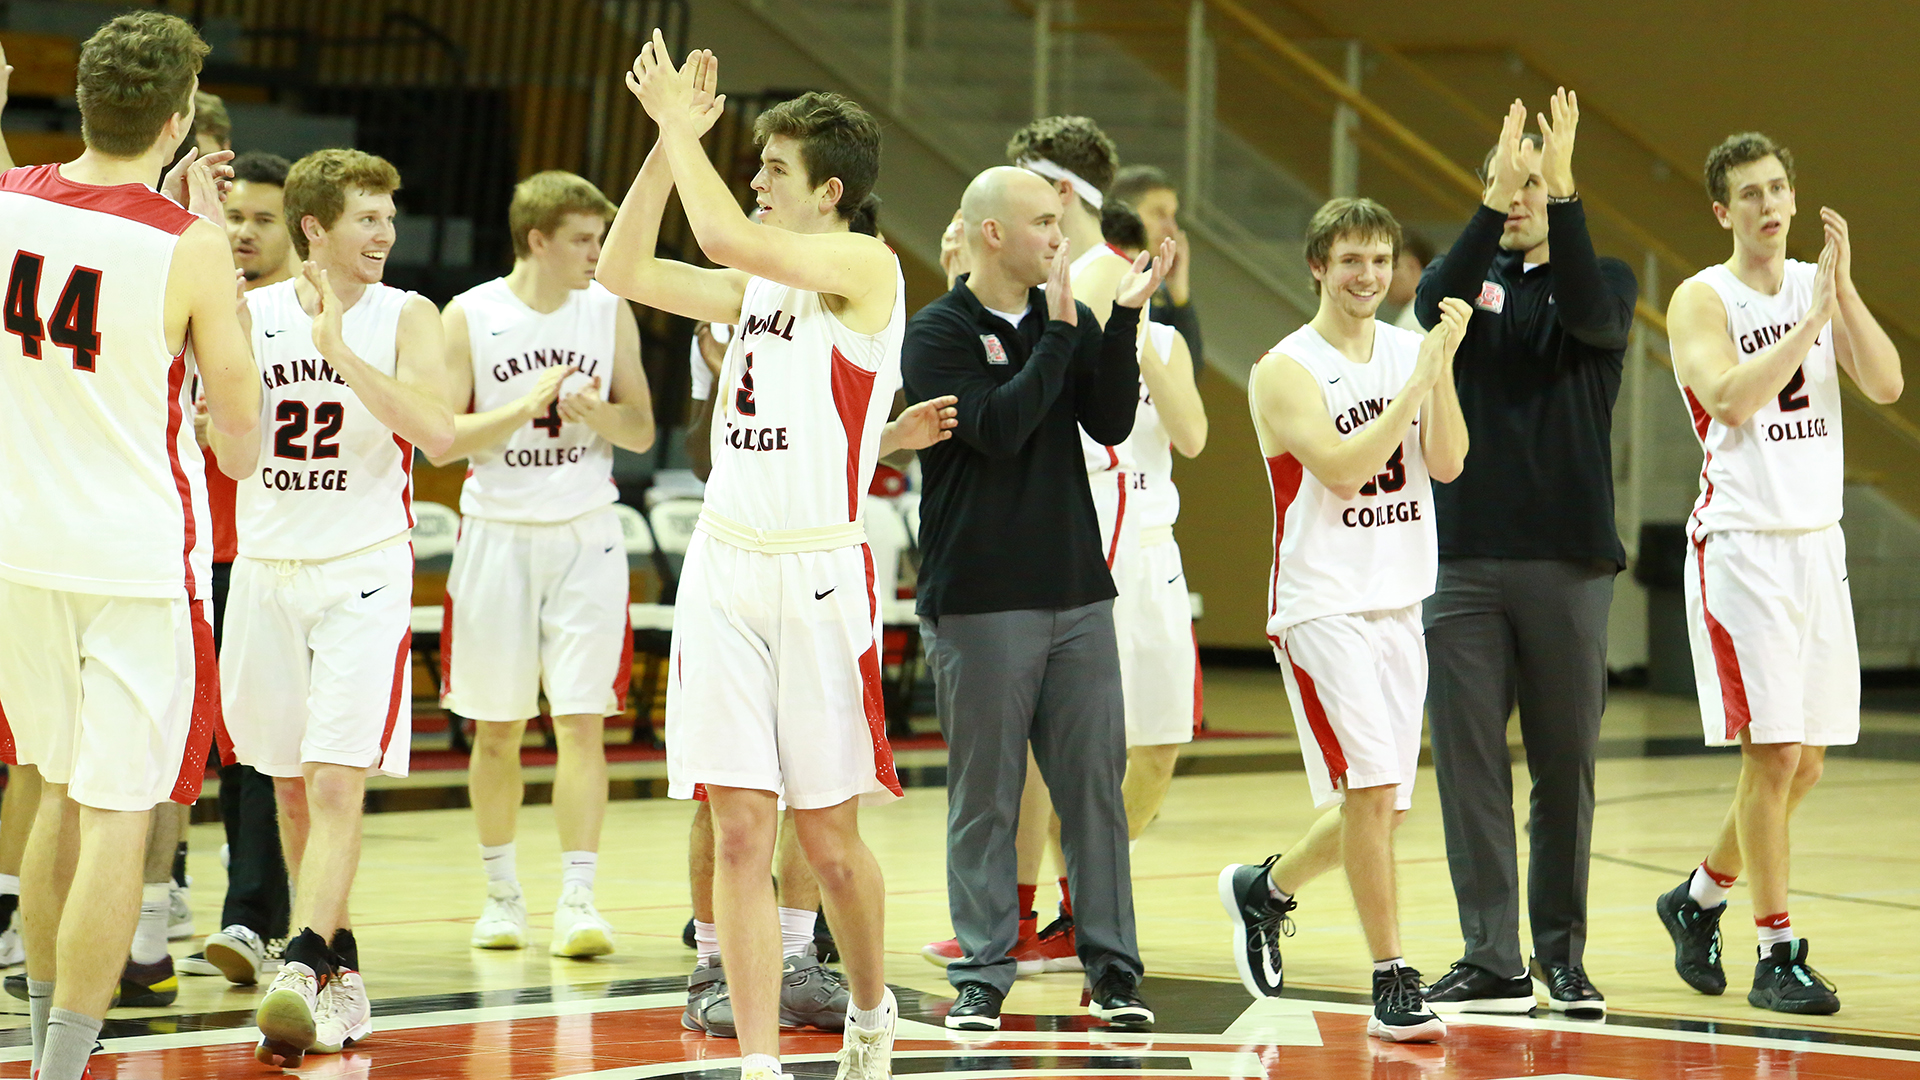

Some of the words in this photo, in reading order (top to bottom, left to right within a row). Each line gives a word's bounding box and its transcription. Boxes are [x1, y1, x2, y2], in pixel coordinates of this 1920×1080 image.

[3, 249, 103, 373] 44
[263, 359, 350, 390] GRINN
[1778, 364, 1810, 413] 2
[274, 399, 345, 461] 22
[533, 395, 562, 438] 4
[1761, 418, 1828, 442] OLLEGE
